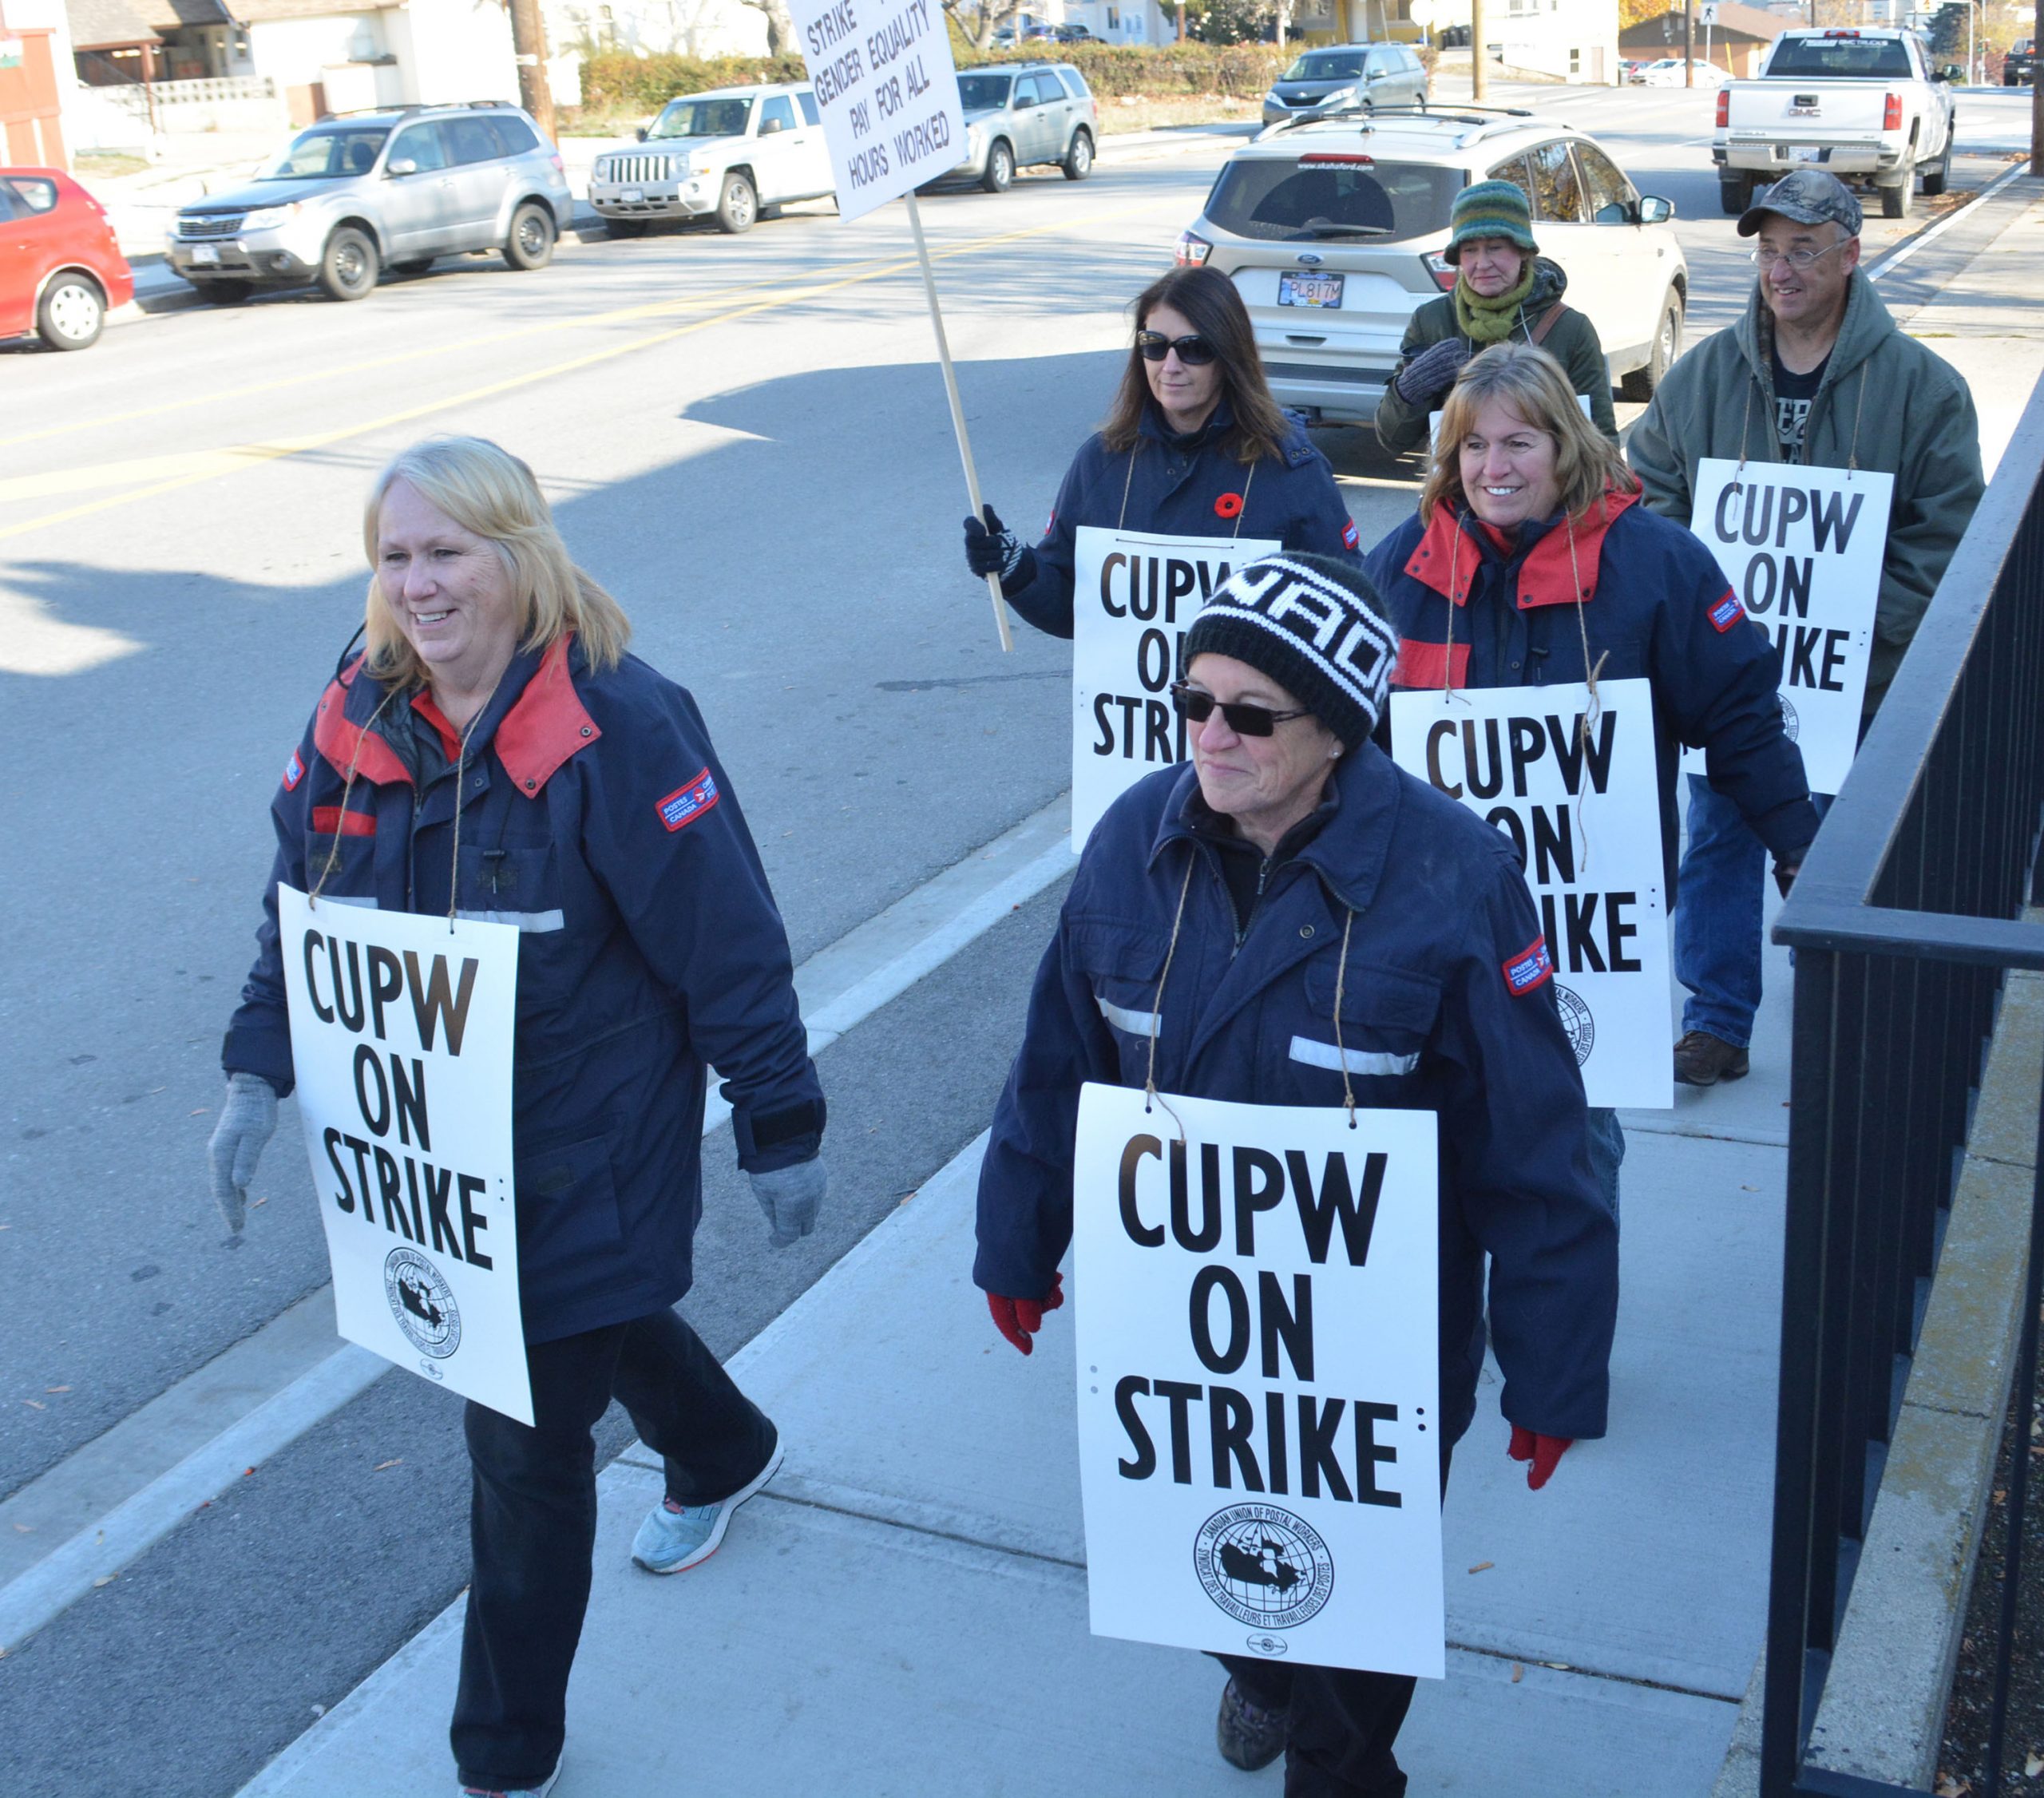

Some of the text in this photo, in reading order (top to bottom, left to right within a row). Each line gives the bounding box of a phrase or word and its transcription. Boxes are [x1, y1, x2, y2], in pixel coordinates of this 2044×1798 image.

[807, 0, 857, 56] STRIKE
[814, 0, 930, 107] GENDER EQUALITY
[850, 54, 930, 139] PAY FOR ALL
[848, 110, 949, 189] HOURS WORKED
[1289, 282, 1340, 299] PL817M
[1714, 482, 1865, 554] CUPW
[1744, 552, 1814, 619] ON
[1750, 620, 1850, 692] IKE
[1094, 693, 1187, 764] STRI
[1427, 711, 1617, 799] CUPW
[664, 797, 687, 814] POSTES
[670, 803, 697, 823] CANADA
[1541, 892, 1642, 972] IKE
[303, 929, 478, 1056] CUPW
[353, 1044, 431, 1151] ON
[323, 1127, 493, 1271] STRIKE
[1118, 1134, 1388, 1266] CUPW
[1189, 1265, 1315, 1382] ON
[1115, 1375, 1402, 1508] STRIKE
[1202, 1507, 1323, 1551] CANADIAN UNION OF POSTAL WORKERS
[1198, 1547, 1330, 1626] SYNDICAT DES TRAVAILLEURS ET TRAVAILLEUSES DES POSTES
